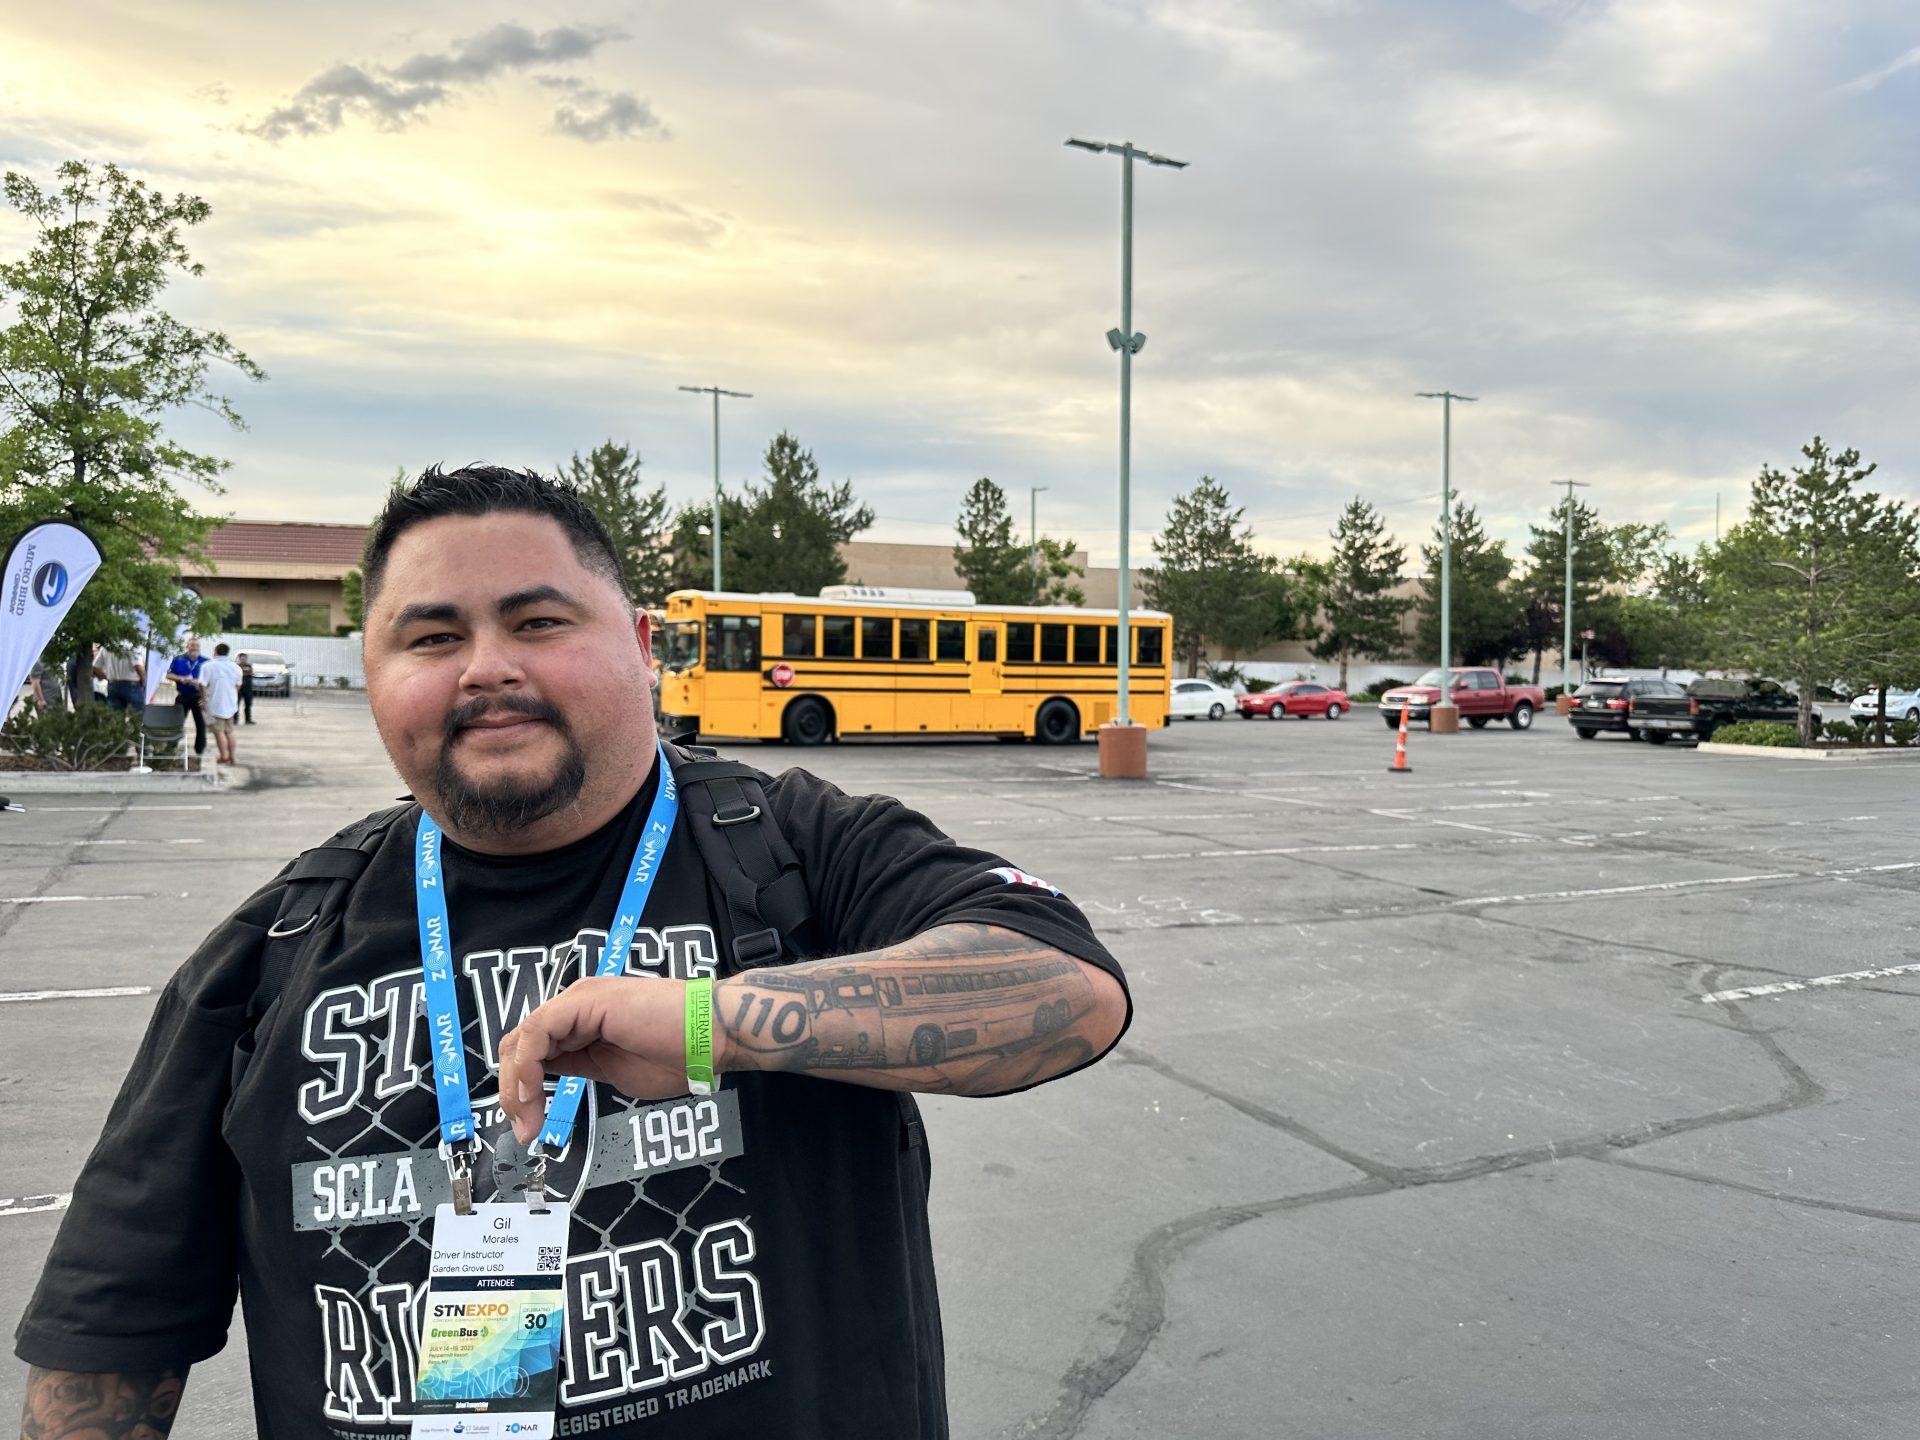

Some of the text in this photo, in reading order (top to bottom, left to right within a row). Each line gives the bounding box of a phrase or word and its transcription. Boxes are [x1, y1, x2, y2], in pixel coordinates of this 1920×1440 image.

[16, 544, 36, 616] MICRO BIRD
[419, 830, 439, 888] ZONAR
[634, 821, 667, 884] ZONAR
[426, 916, 448, 982] ZONAR
[602, 914, 634, 977] ZONA
[699, 990, 711, 1057] PEPPERMILL
[735, 992, 806, 1043] 110
[437, 1012, 461, 1087] ZONAR
[629, 1099, 723, 1171] 1992
[313, 1157, 421, 1222] SCLA
[482, 1235, 519, 1244] Morales
[493, 1217, 511, 1230] Gil
[432, 1263, 504, 1272] Garden Grove USD
[433, 1250, 504, 1260] Driver Instructor
[477, 1279, 515, 1287] ATTENDEE
[431, 1327, 478, 1338] GreenBus
[524, 1313, 548, 1330] 30
[419, 1366, 530, 1400] RENO
[665, 1360, 773, 1410] TRADEMARK
[505, 1422, 538, 1434] ZONAR
